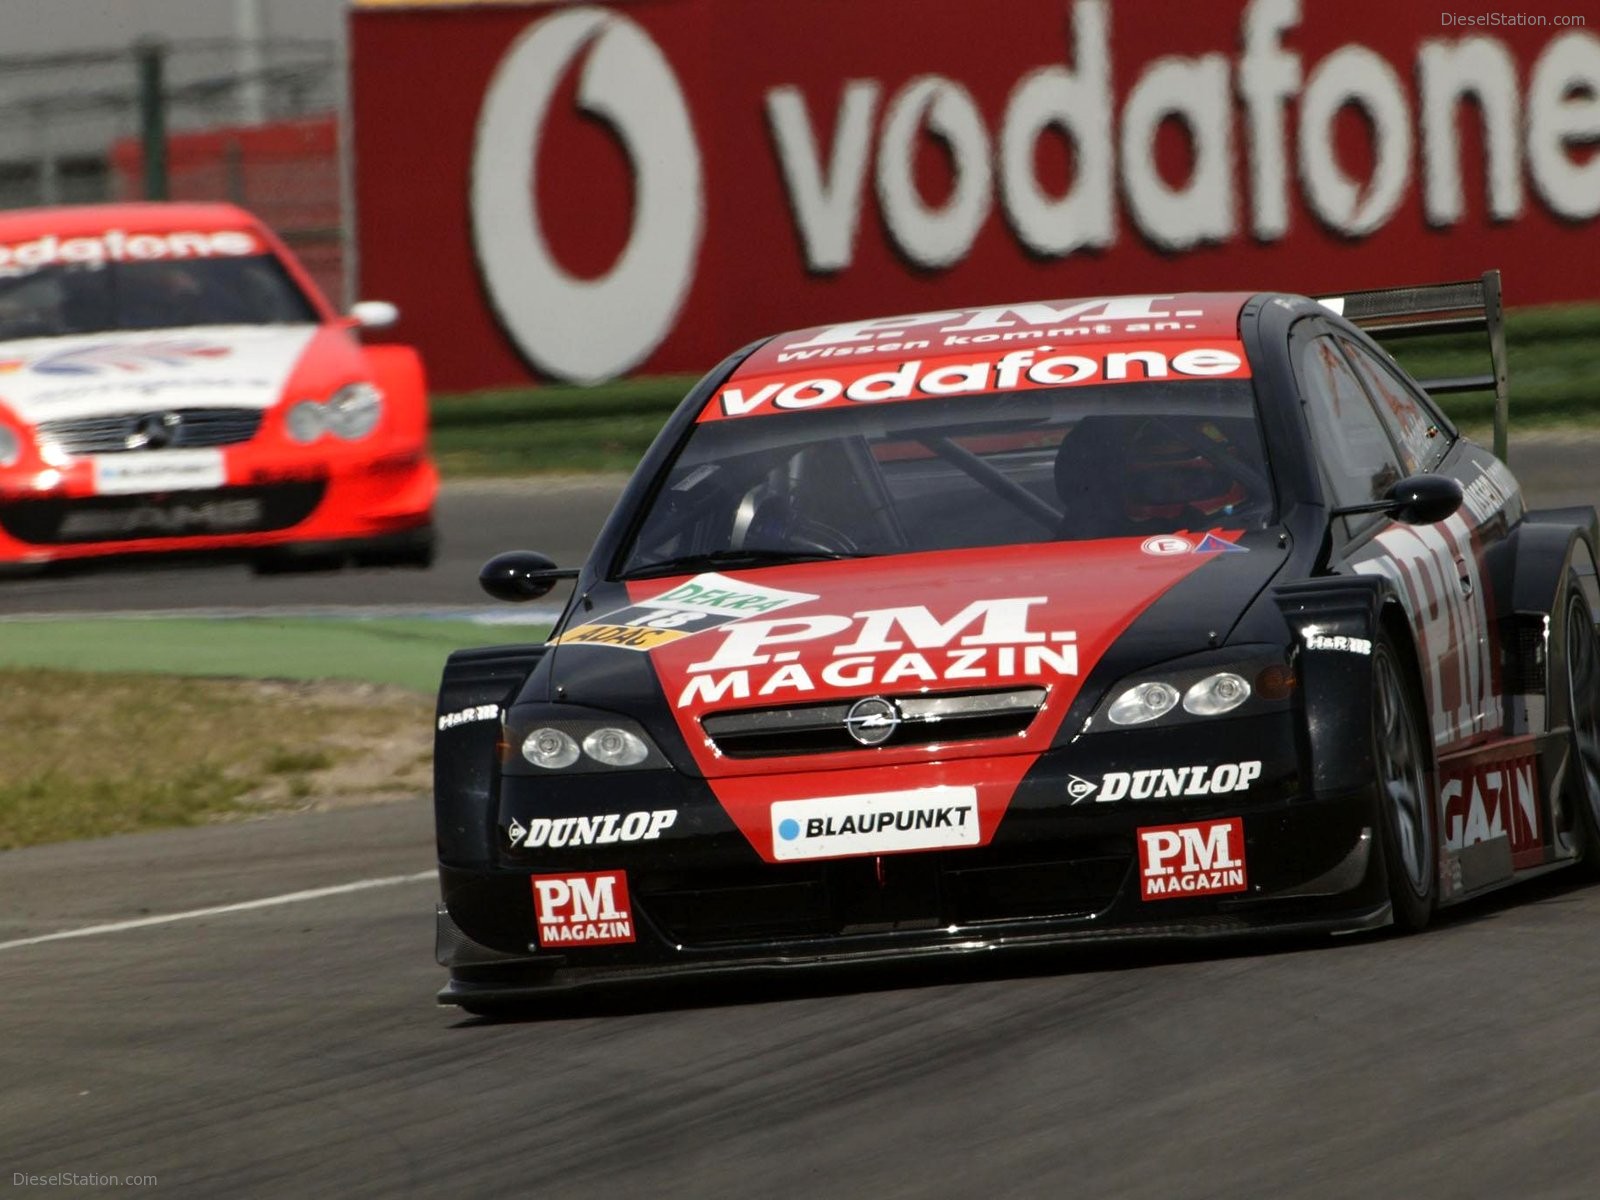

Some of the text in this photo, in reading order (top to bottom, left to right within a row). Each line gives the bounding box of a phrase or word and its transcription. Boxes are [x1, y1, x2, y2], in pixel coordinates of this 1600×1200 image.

[765, 0, 1600, 274] vodafone
[777, 319, 1197, 364] Wissen kommt an.
[721, 347, 1242, 416] vodafone
[659, 583, 790, 612] DEKRA
[567, 626, 665, 646] ADAC
[685, 596, 1078, 674] P.M.
[677, 643, 1079, 709] MAGAZIN
[1095, 760, 1262, 802] DUNLOP
[523, 809, 678, 848] DUNLOP
[805, 806, 972, 838] BLAUPUNKT
[1141, 823, 1242, 876] P.M.
[535, 876, 628, 924] P.M.
[1146, 869, 1244, 894] MAGAZIN
[543, 921, 631, 942] MAGAZIN
